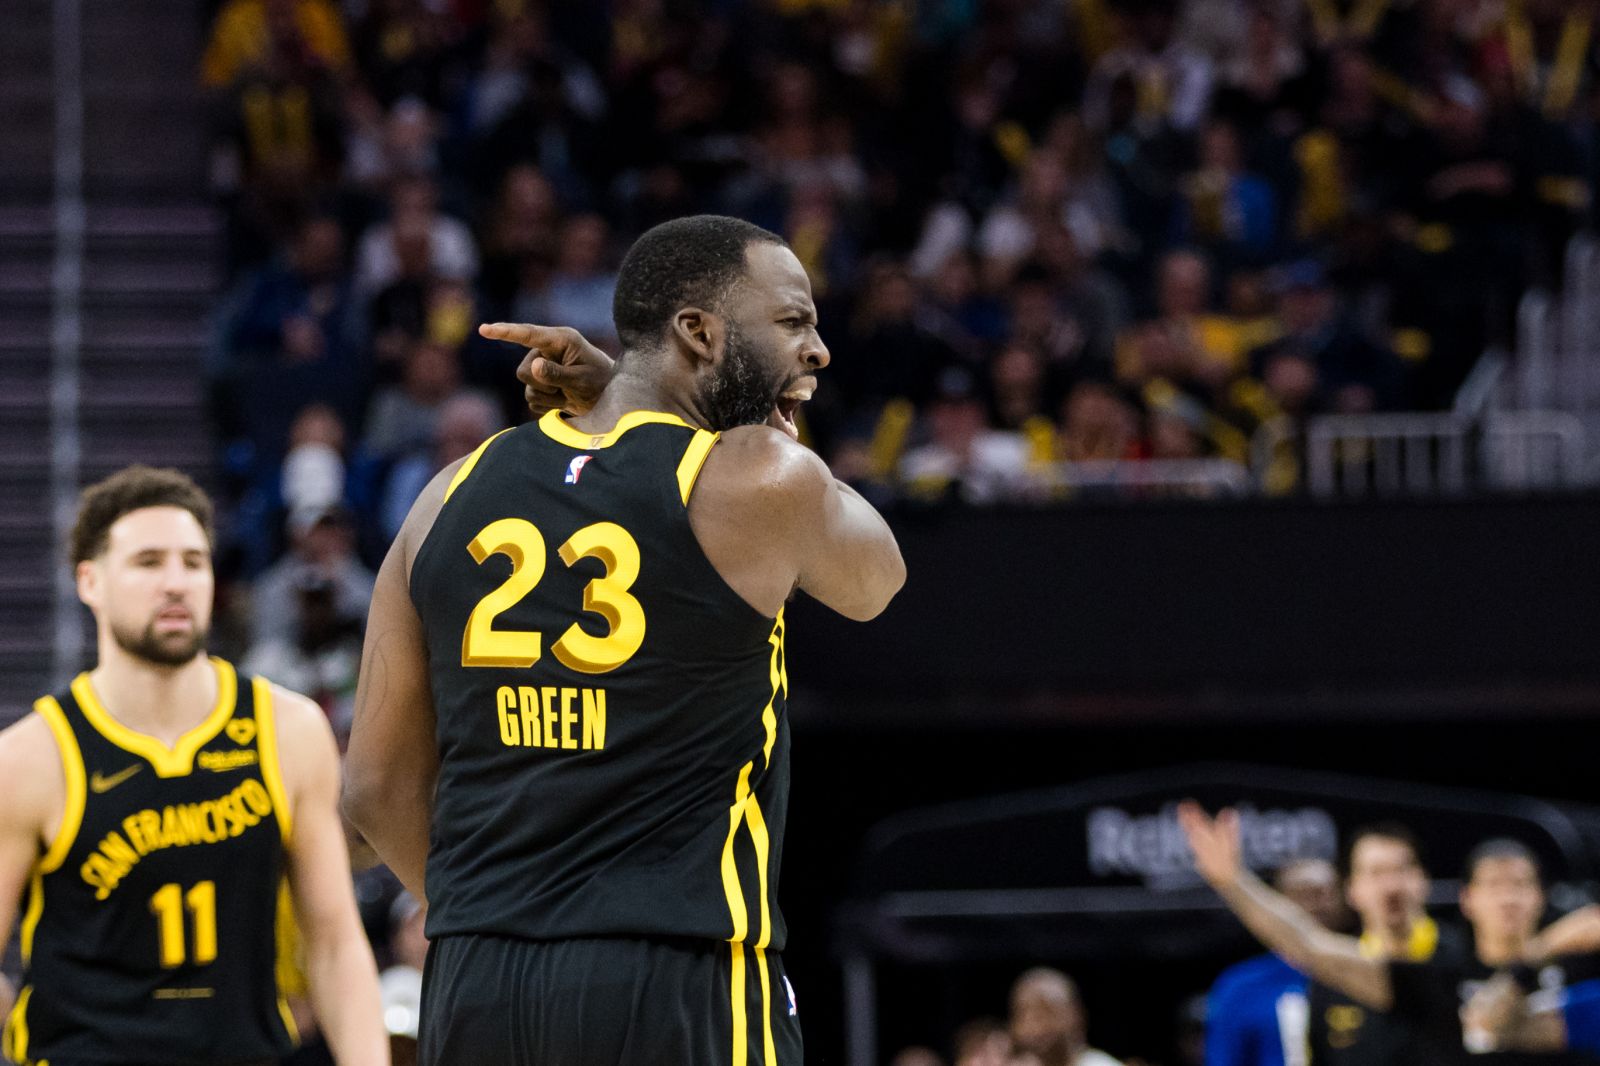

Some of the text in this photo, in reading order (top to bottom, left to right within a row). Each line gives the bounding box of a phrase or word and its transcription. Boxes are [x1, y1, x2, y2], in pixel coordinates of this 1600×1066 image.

[461, 518, 646, 674] 23
[496, 686, 607, 750] GREEN
[80, 778, 273, 901] SAN FRANCISCO
[151, 879, 218, 969] 11
